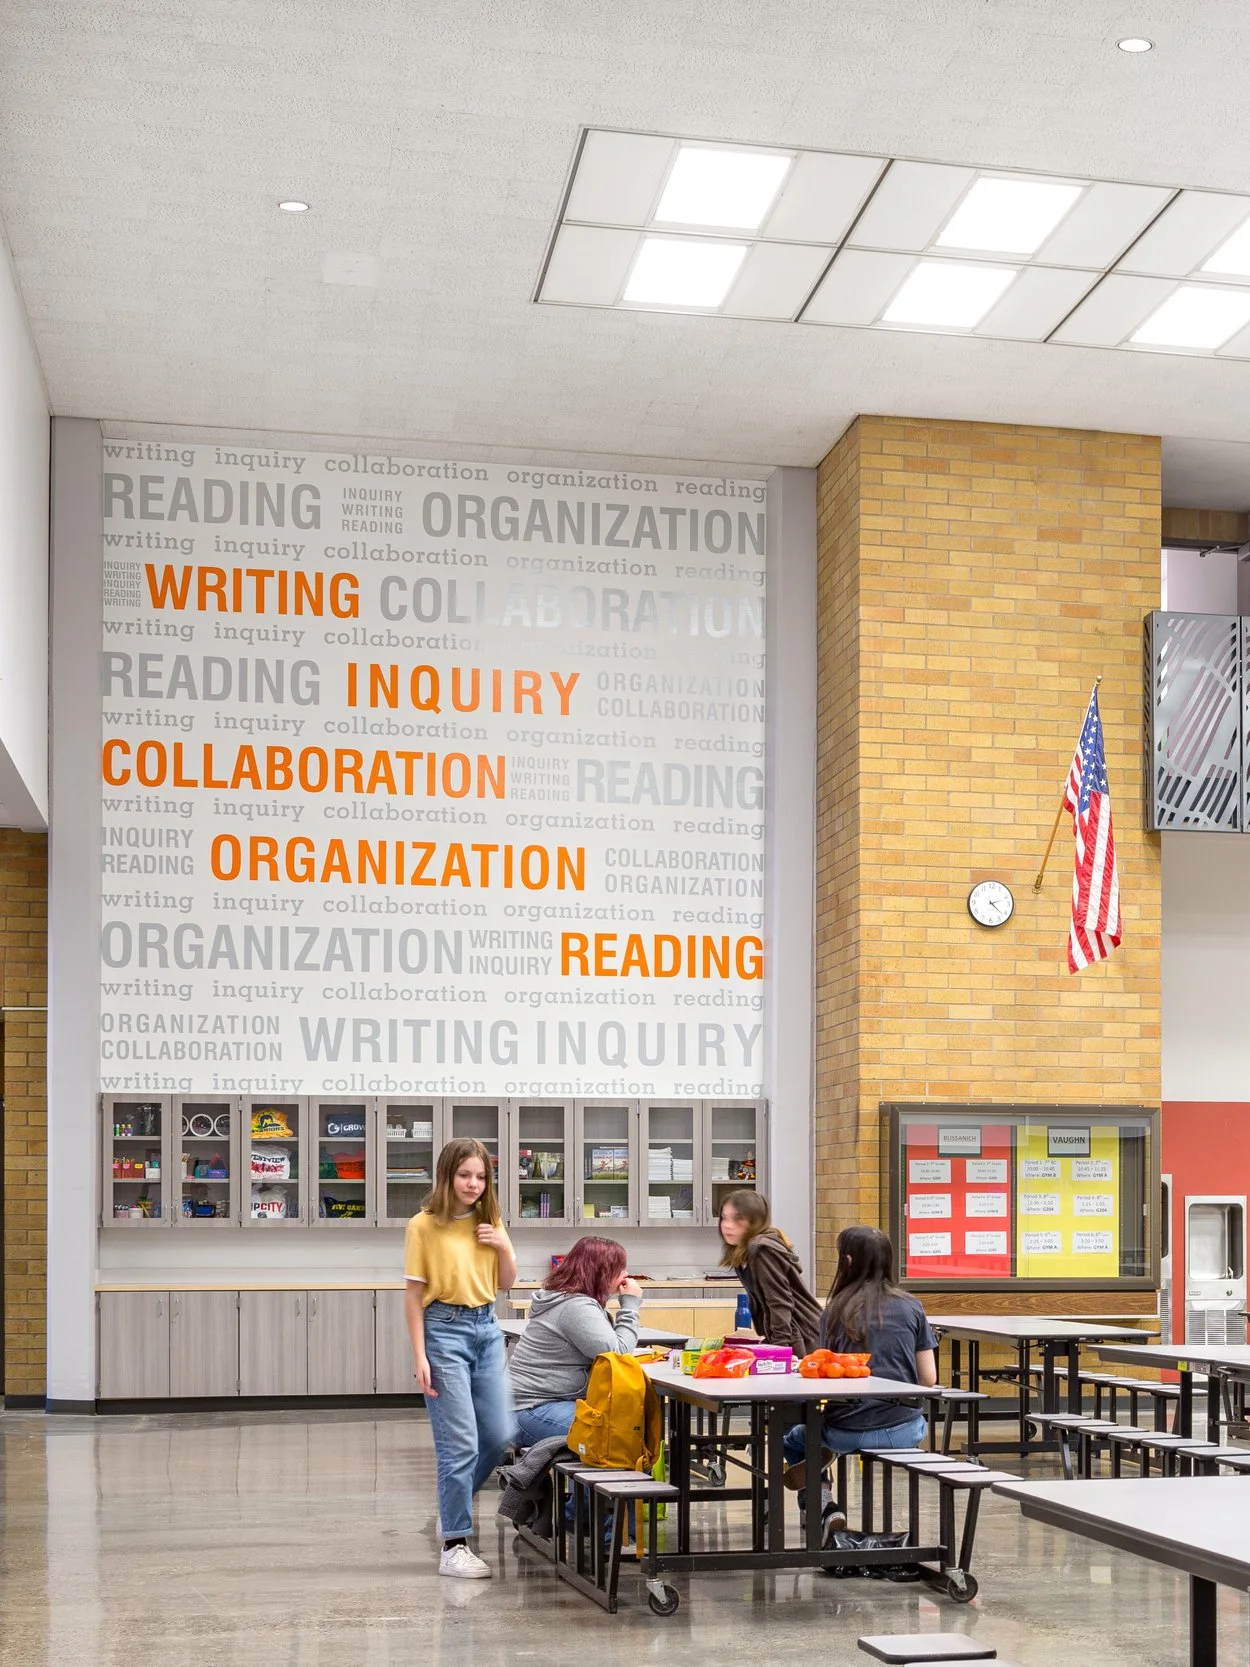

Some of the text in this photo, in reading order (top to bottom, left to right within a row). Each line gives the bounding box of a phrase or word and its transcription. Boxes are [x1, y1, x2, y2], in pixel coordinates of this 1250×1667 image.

[102, 444, 766, 503] writing inquiry collaboration organization reading
[343, 487, 402, 502] INQUIRY
[103, 473, 765, 555] READING ORGANIZATION
[342, 504, 403, 518] WRITING
[342, 519, 403, 534] READING
[103, 532, 766, 586] writing inquiry collaboration organization reading
[104, 561, 141, 571] INQUIRY
[104, 571, 141, 580] WRITING
[104, 580, 141, 589] INQUIRY
[104, 589, 141, 598] READING
[104, 598, 141, 607] WRITING
[145, 563, 359, 619] WRITING
[103, 620, 195, 642] writing
[214, 621, 305, 647] inquiry
[103, 651, 580, 715] READING INQUIRY
[597, 671, 765, 698] ORGANIZATION
[597, 698, 765, 723] COLLABORATION
[103, 709, 766, 758] writing inquiry collaboration organization reading
[102, 739, 764, 810] COLLABORATION READING
[512, 757, 569, 771] INQUIRY
[511, 772, 570, 786] WRITING
[511, 788, 570, 801] READING
[102, 795, 765, 840] writing inquiry collaboration organization reading
[102, 827, 193, 848] INQUIRY
[102, 854, 193, 875] READING
[211, 834, 585, 891] ORGANIZATION
[605, 847, 764, 873] COLLABORATION
[604, 873, 764, 898] ORGANIZATION
[102, 890, 764, 929] writing inquiry collaboration organization reading
[101, 921, 764, 981] ORGANIZATION READING
[469, 929, 553, 950] WRITING
[469, 956, 553, 976] INQUIRY
[102, 979, 764, 1011] writing inquiry collaboration organization reading
[101, 1013, 280, 1035] ORGANIZATION
[101, 1039, 283, 1061] COLLABORATION
[299, 1016, 762, 1070] WRITING INQUIRY
[102, 1072, 764, 1098] writing inquiry collaboration organization reading
[1053, 1136, 1086, 1144] VAUGHN
